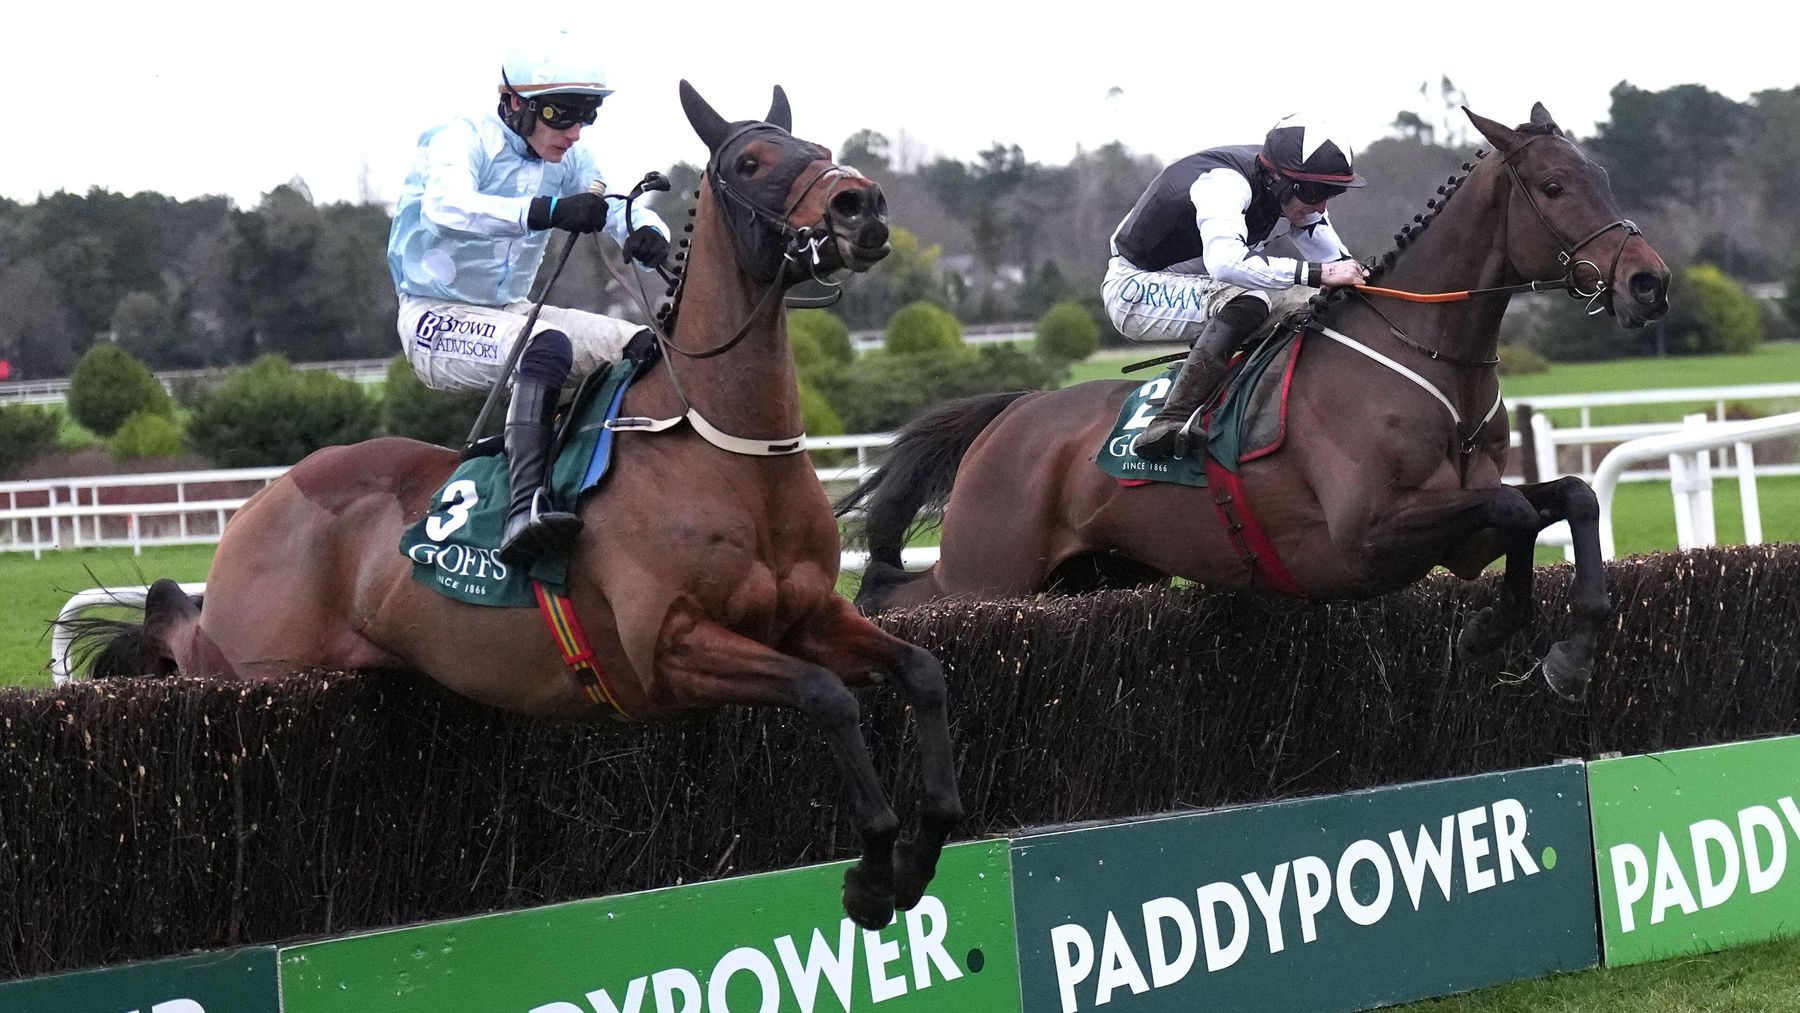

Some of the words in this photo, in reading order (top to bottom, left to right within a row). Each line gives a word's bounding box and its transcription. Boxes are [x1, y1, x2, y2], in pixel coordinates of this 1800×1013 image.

[439, 315, 496, 338] Brown
[436, 338, 498, 359] ADVISORY
[1123, 378, 1171, 430] 2
[1122, 462, 1145, 470] SINCE
[1149, 463, 1168, 472] 1866
[426, 480, 479, 541] 3
[409, 544, 507, 580] GOFFS
[465, 584, 486, 595] 1866
